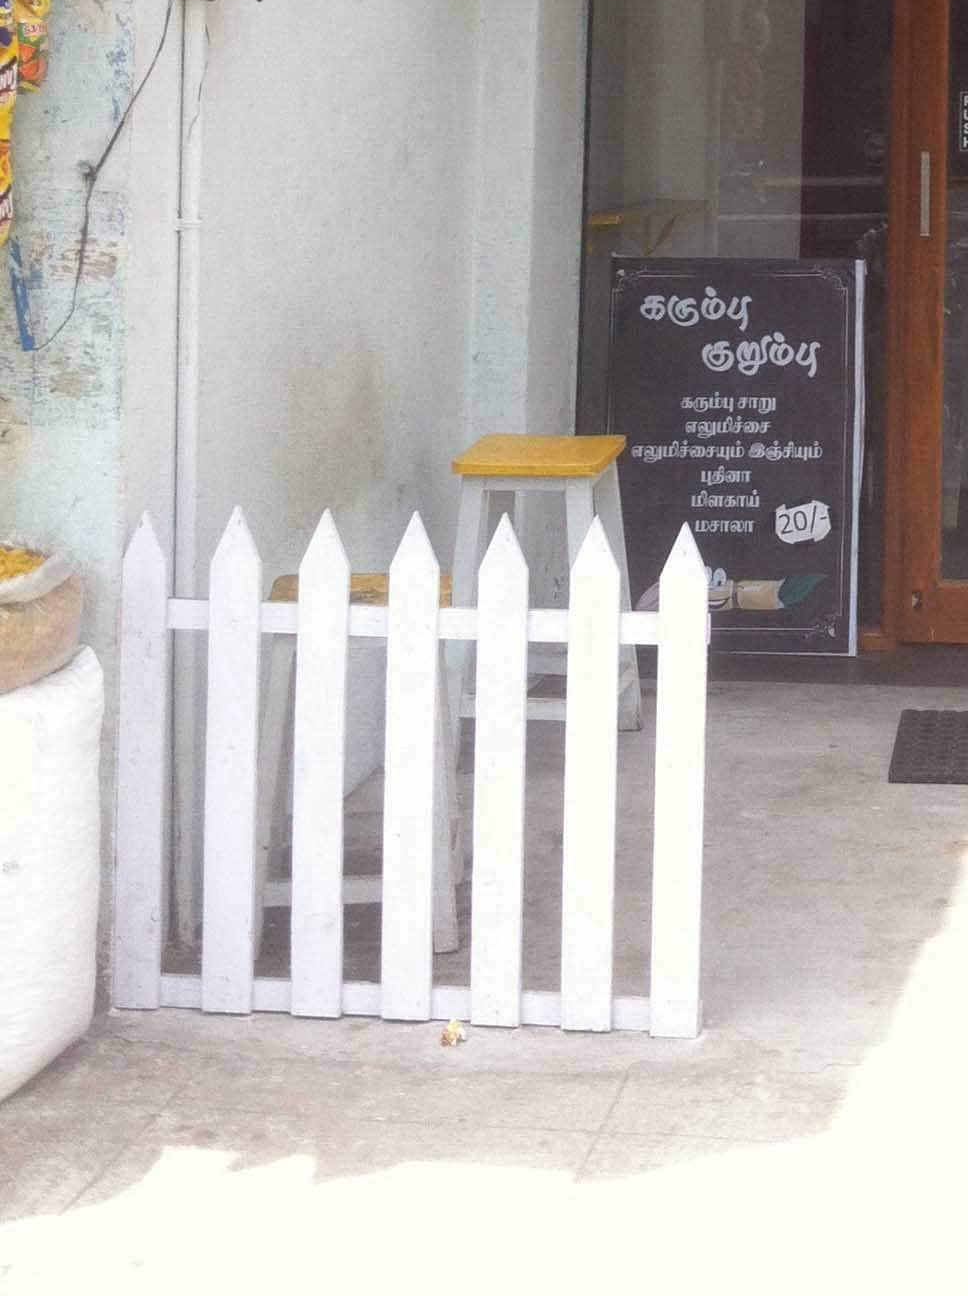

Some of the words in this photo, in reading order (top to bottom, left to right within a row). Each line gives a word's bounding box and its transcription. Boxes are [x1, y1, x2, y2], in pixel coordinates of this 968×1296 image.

[639, 286, 752, 331] கரும்பு
[701, 331, 821, 378] குறும்பு
[680, 392, 734, 413] கரும்பு
[737, 395, 777, 414] சாறு
[685, 415, 771, 439] எலுமிச்சை
[700, 465, 751, 486] புதினா
[691, 489, 760, 508] மிளகாய்
[694, 518, 755, 534] மசாலா
[778, 504, 828, 535] 20/-
